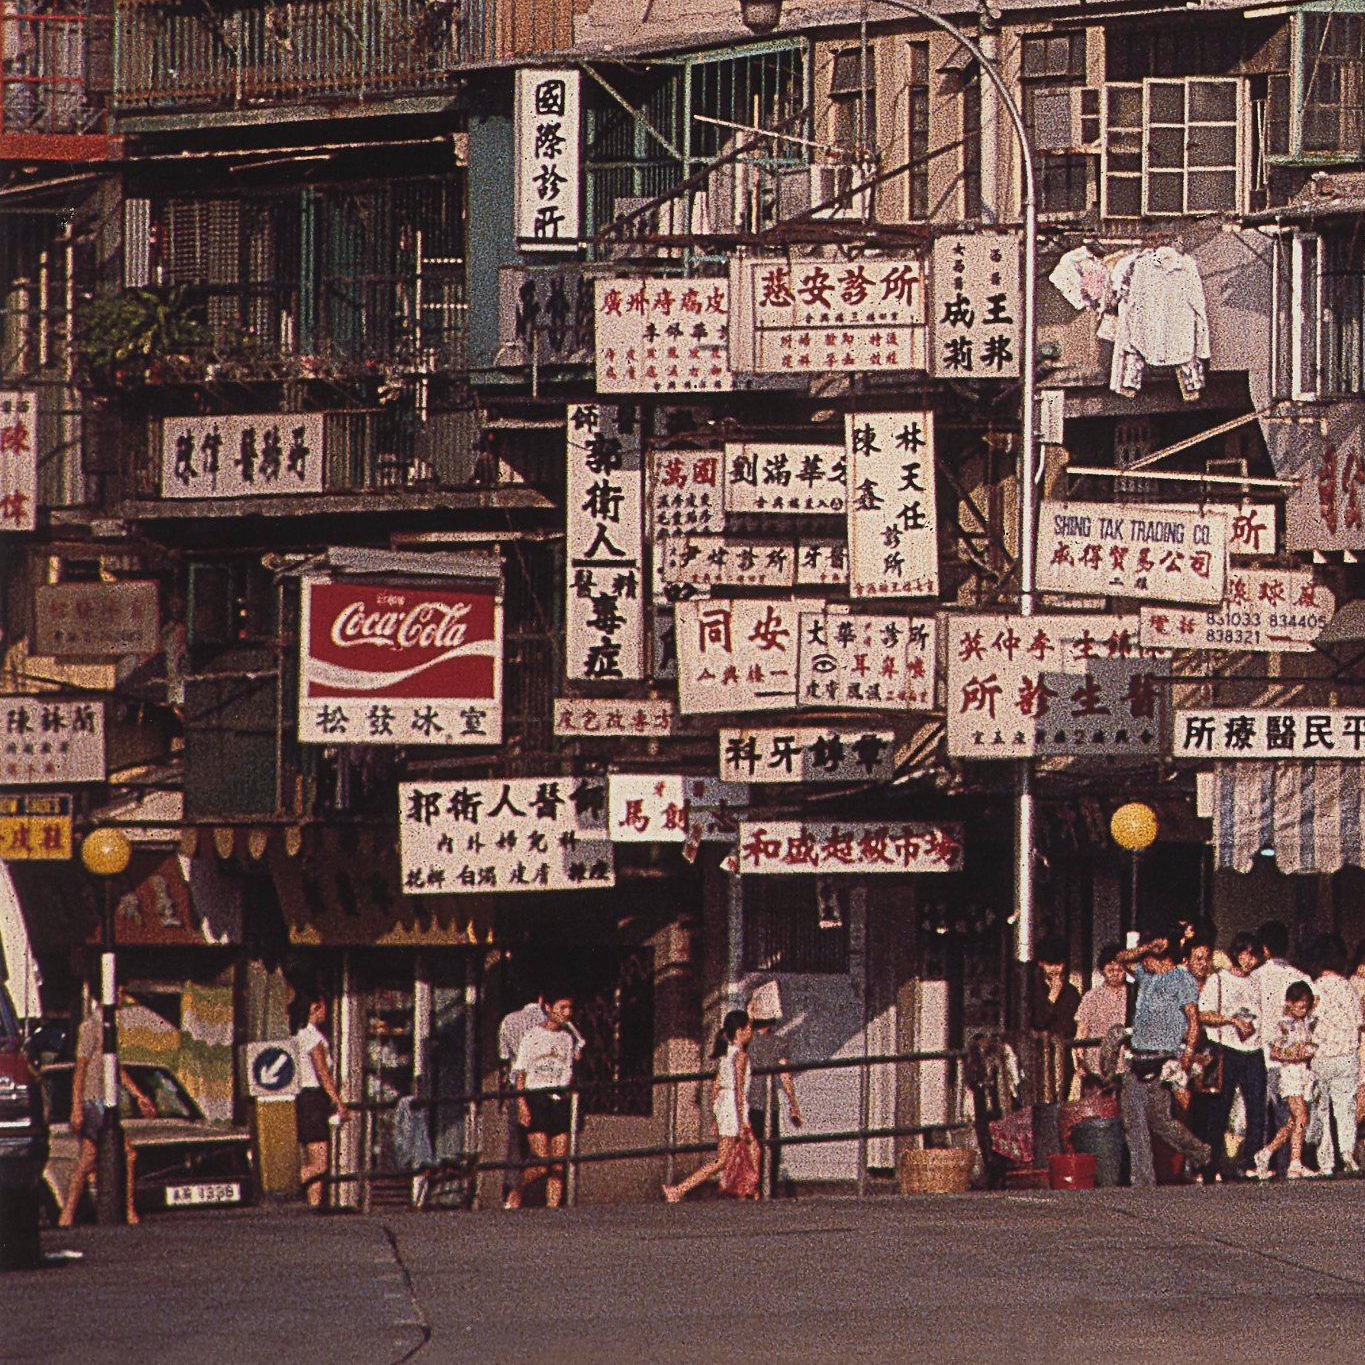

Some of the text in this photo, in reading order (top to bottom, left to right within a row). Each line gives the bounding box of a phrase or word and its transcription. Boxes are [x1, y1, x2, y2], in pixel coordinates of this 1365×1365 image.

[533, 79, 567, 238] 國際診所
[1053, 514, 1092, 540] SHING
[1099, 518, 1124, 542] TAK
[1130, 520, 1186, 545] TRADING
